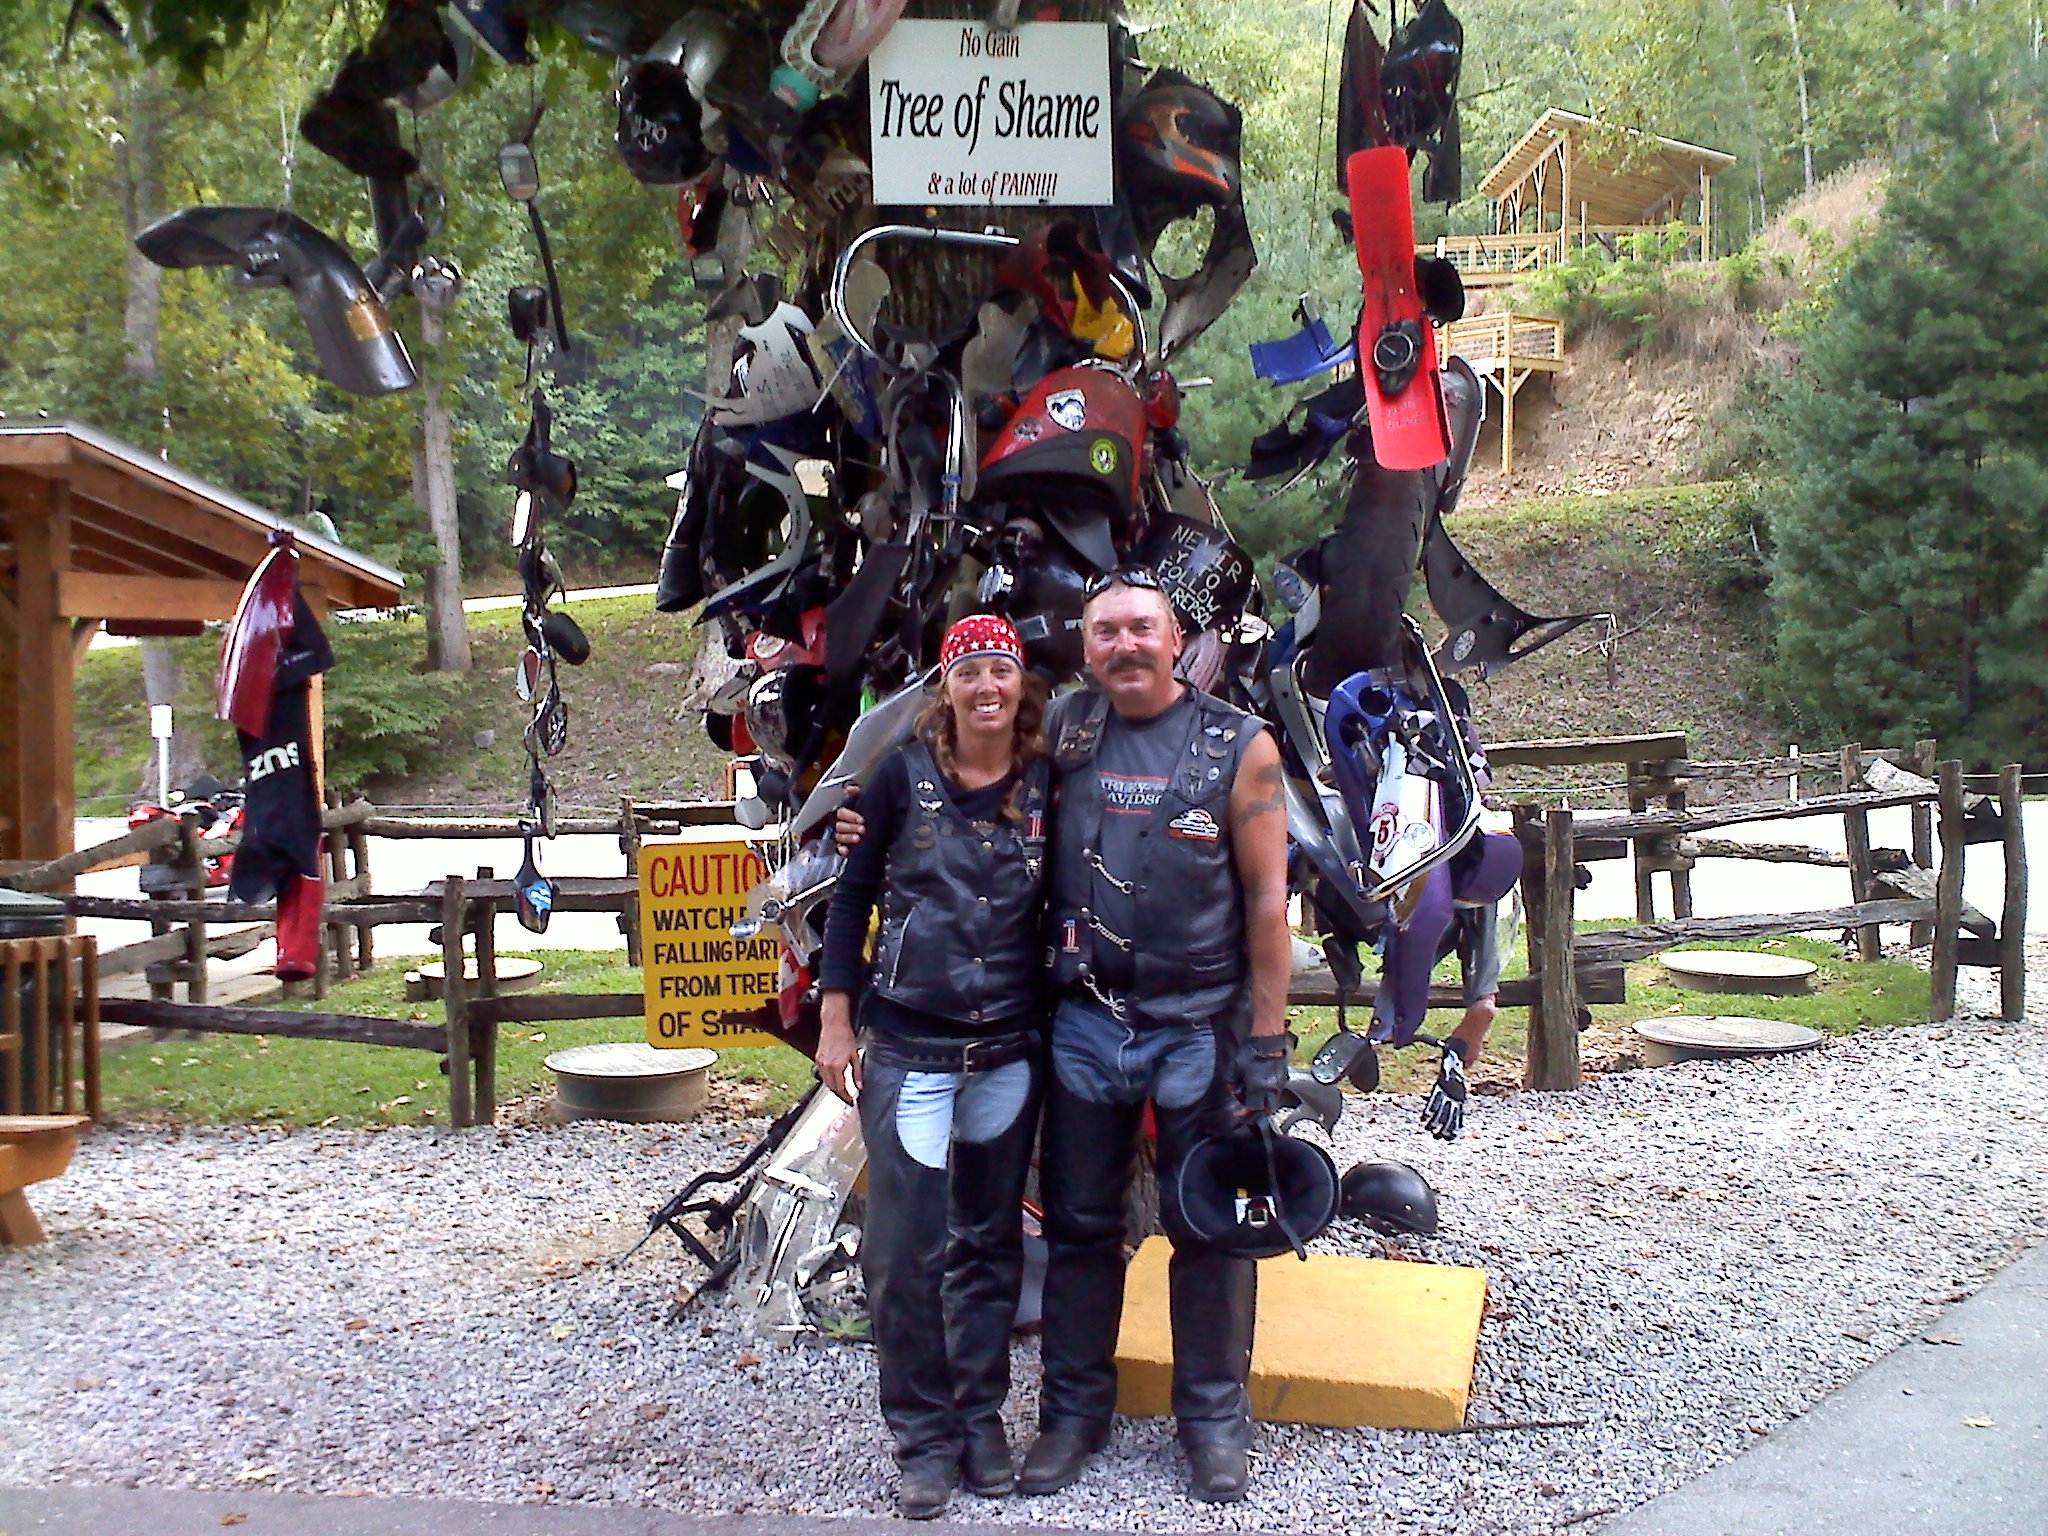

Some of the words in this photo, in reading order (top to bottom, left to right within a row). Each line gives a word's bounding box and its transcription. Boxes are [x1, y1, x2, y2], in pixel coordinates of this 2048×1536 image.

[960, 27, 981, 57] No
[985, 29, 1019, 58] Gain
[880, 79, 944, 138] Tree
[954, 75, 990, 156] of
[995, 79, 1101, 138] Shame
[928, 171, 942, 195] &
[944, 177, 954, 195] a
[958, 171, 977, 196] lot
[981, 171, 999, 202] of
[1157, 558, 1221, 612] FOLLOW
[650, 853, 768, 897] CAUTIO
[652, 906, 735, 932] WATCH
[654, 940, 733, 965] FALLING
[735, 938, 778, 961] PART
[660, 973, 721, 999] FROM
[658, 1011, 692, 1038] OF
